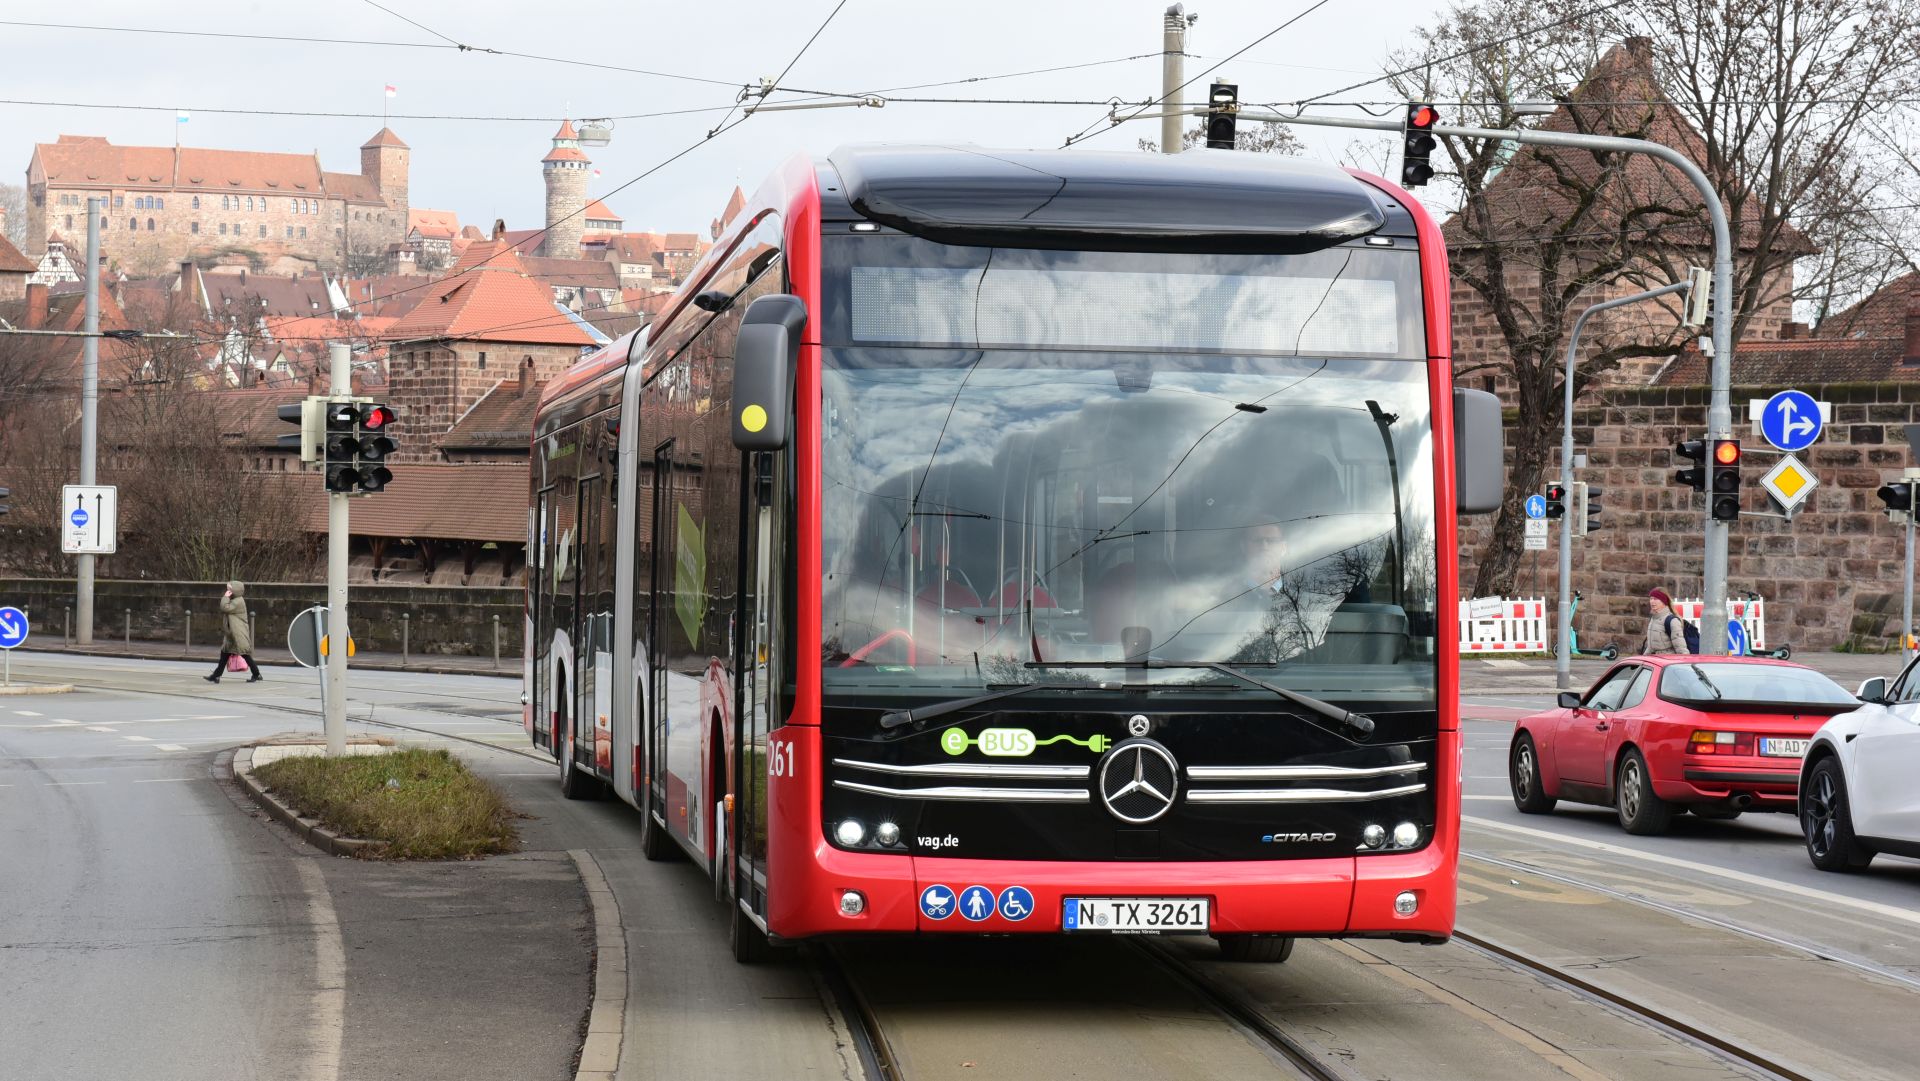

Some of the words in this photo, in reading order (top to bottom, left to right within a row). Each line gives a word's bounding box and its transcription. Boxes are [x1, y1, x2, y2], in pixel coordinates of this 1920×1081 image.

[947, 732, 962, 750] e
[984, 732, 1029, 751] BUS
[1768, 740, 1776, 752] N
[1784, 741, 1799, 752] AD
[769, 740, 794, 777] 261
[917, 833, 959, 850] vag.de
[1262, 832, 1337, 842] eCITARO
[1080, 903, 1094, 925] N
[1111, 903, 1141, 925] TX
[1146, 903, 1203, 926] 3261
